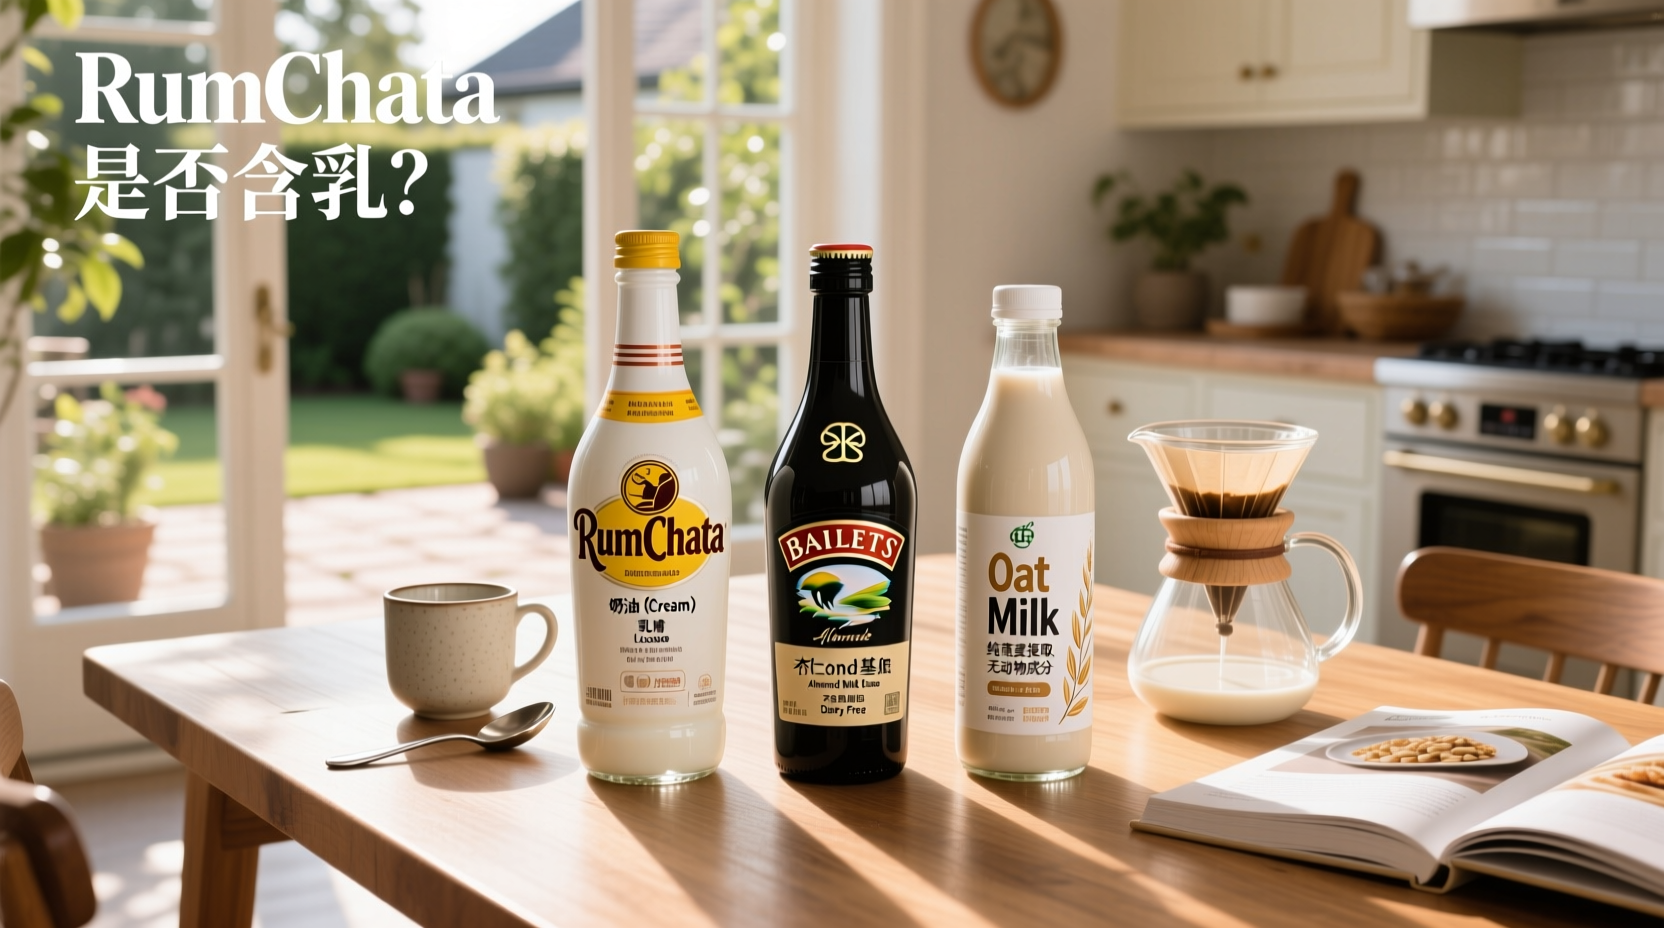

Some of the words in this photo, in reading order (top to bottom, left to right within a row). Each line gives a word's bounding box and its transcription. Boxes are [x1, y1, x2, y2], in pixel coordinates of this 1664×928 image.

[573, 508, 725, 572] RumChata
[786, 528, 898, 561] BAILETS
[988, 552, 1050, 593] Oat
[988, 596, 1060, 636] Milk
